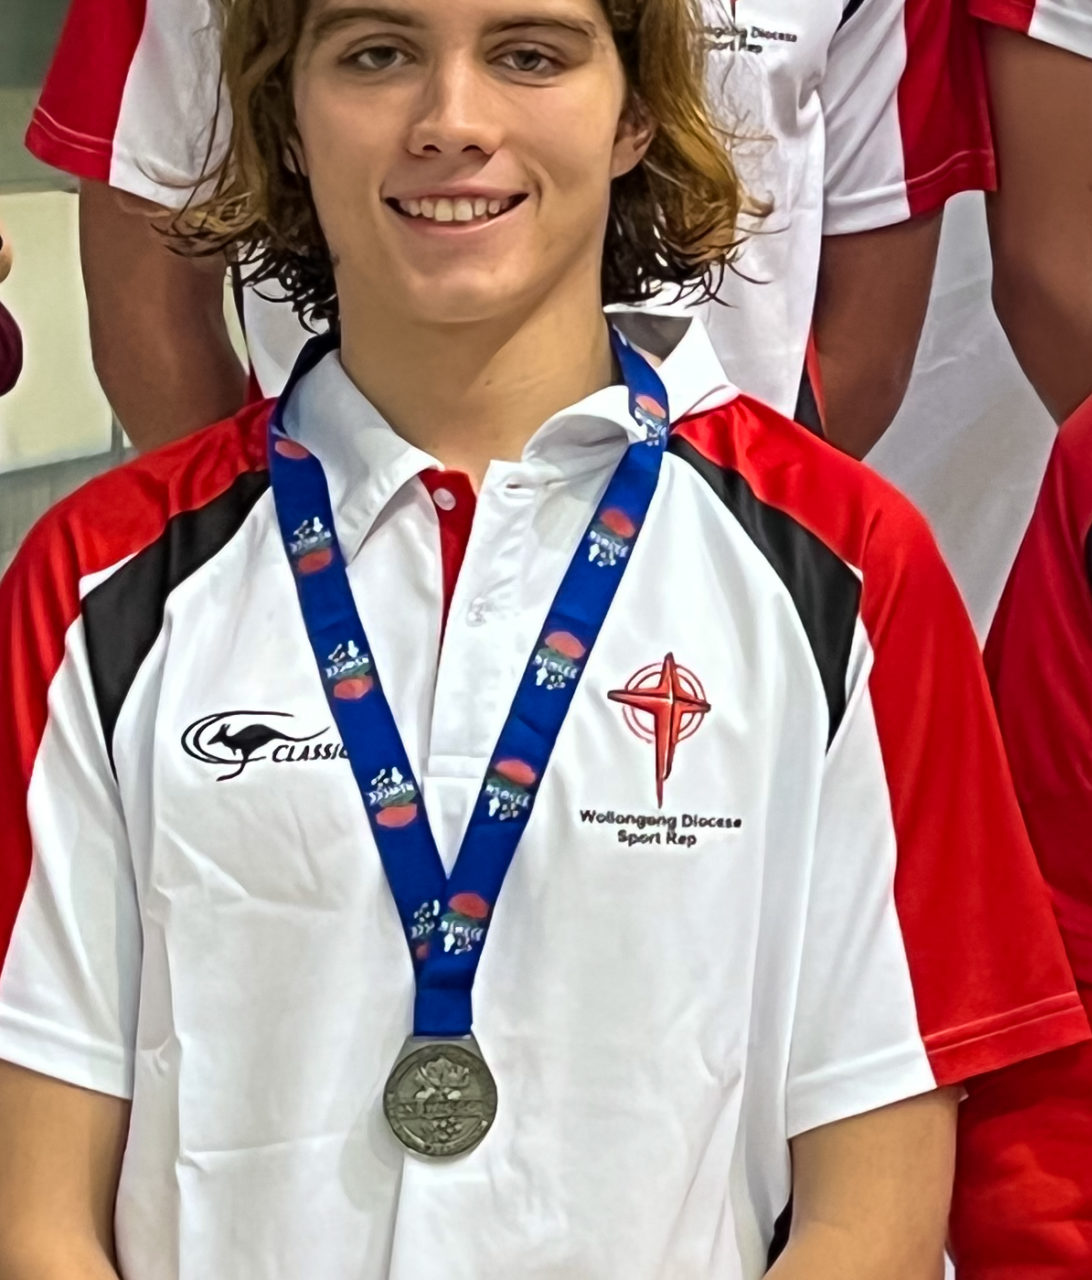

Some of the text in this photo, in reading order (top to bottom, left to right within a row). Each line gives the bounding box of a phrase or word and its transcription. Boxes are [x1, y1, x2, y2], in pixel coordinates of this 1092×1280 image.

[579, 809, 742, 829] Wollongong Diocese
[617, 830, 697, 848] Sport Rep
